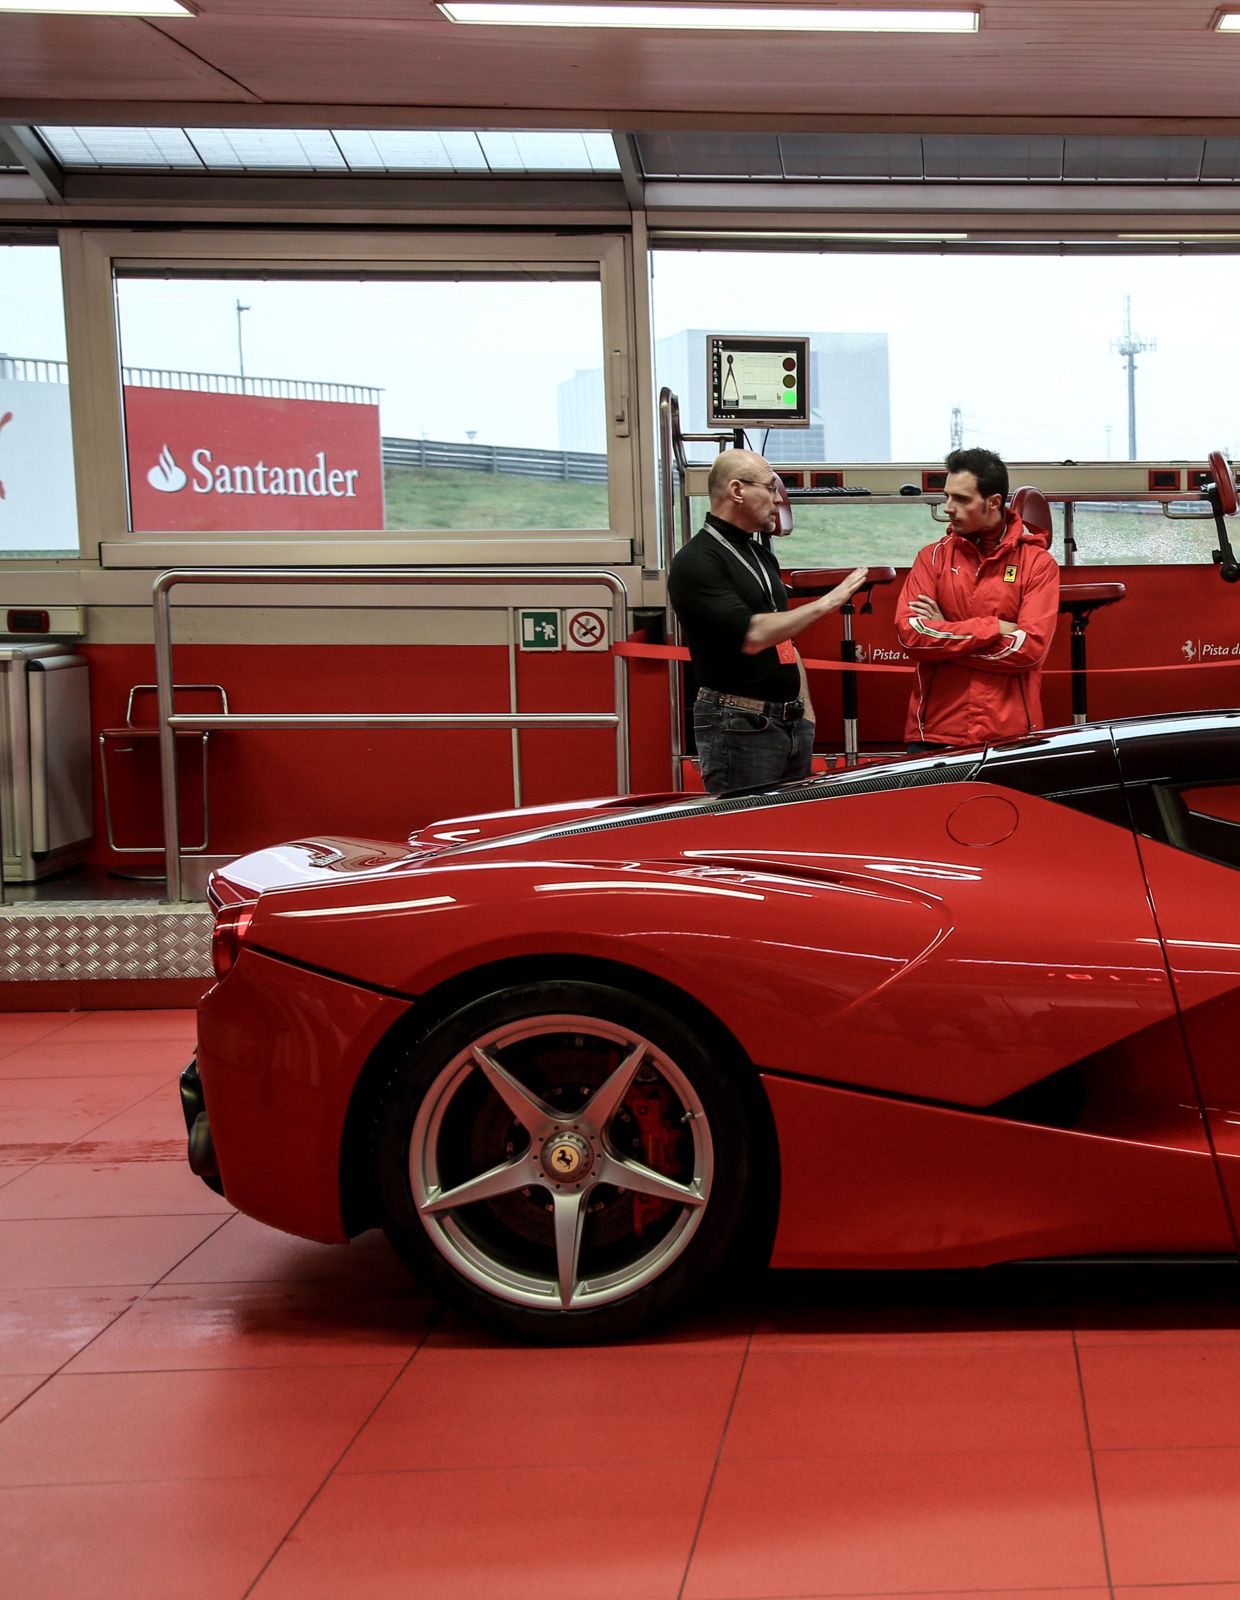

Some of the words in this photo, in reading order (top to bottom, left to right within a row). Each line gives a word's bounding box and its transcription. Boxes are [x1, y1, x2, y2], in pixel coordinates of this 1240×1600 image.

[192, 448, 359, 497] Santander
[872, 648, 900, 660] Pista
[1202, 644, 1229, 656] Pista
